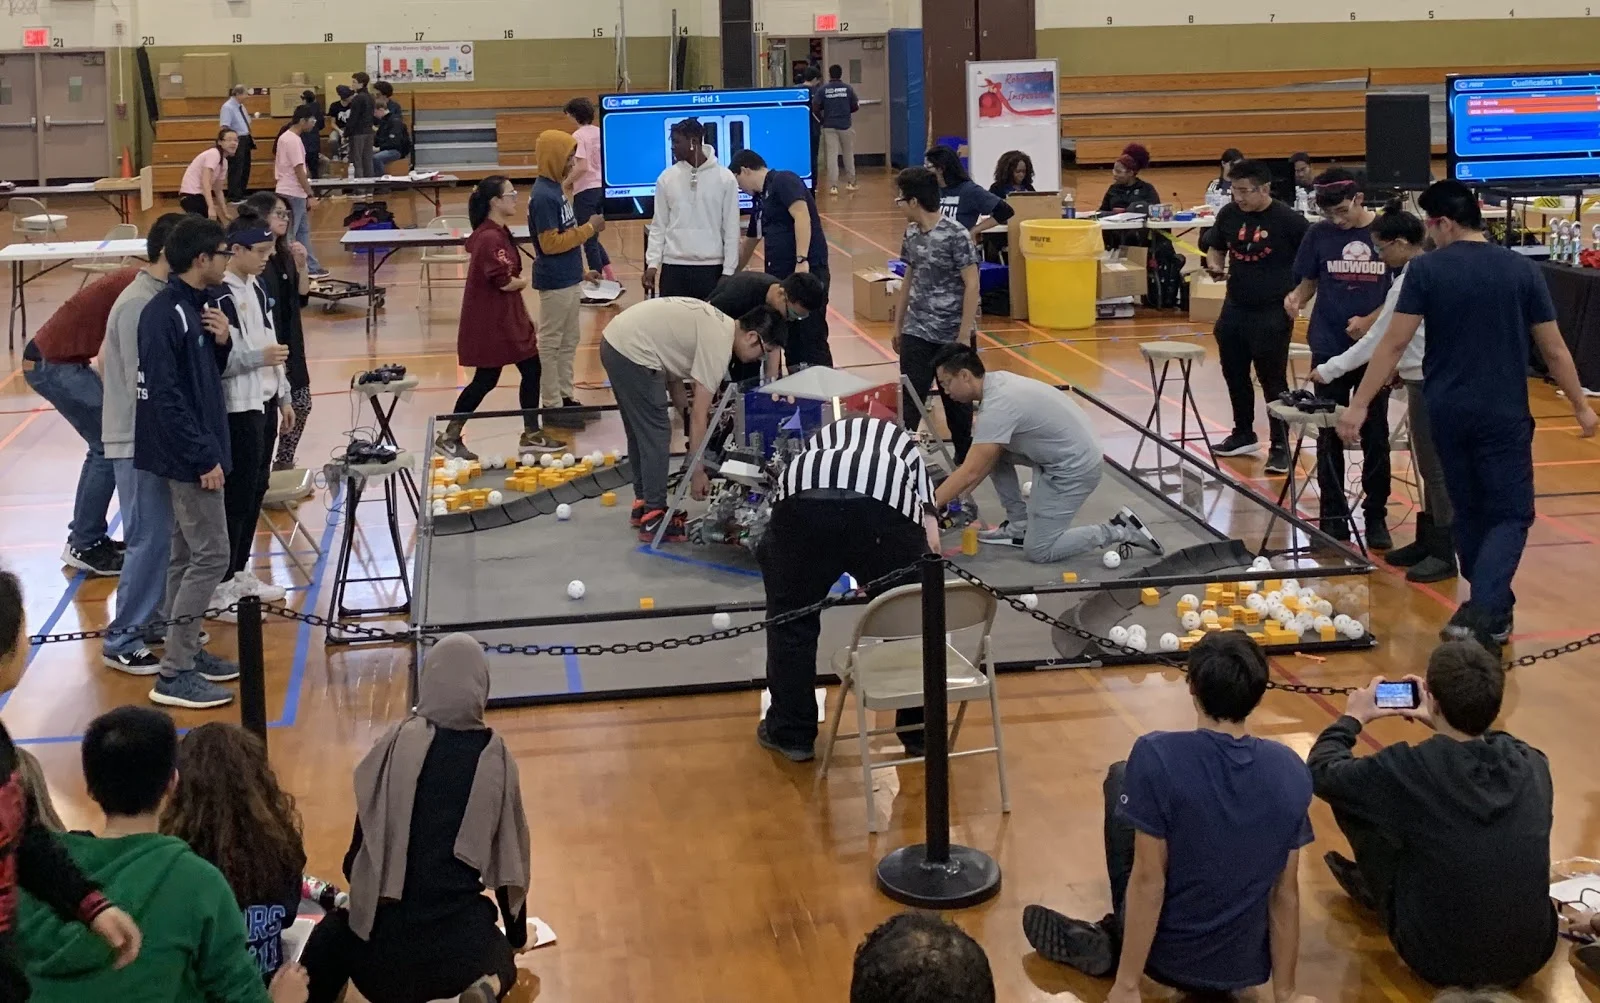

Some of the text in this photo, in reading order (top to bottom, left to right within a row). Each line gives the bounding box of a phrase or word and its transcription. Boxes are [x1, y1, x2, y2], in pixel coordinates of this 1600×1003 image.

[1350, 12, 1356, 20] 6
[1428, 10, 1434, 19] 5
[1508, 9, 1515, 17] 4
[1585, 7, 1591, 16] 3
[1106, 16, 1112, 25] 9
[1188, 15, 1194, 23] 8
[1269, 14, 1275, 23] 7
[678, 26, 688, 36] 14
[839, 22, 849, 32] 12
[415, 32, 424, 41] 17
[503, 30, 514, 39] 16
[592, 28, 603, 37] 15
[142, 36, 155, 46] 20
[232, 34, 242, 43] 19
[324, 33, 333, 42] 18
[53, 38, 64, 48] 21
[692, 95, 713, 104] Field
[1327, 261, 1385, 274] MIDWOOD
[245, 905, 286, 942] RS
